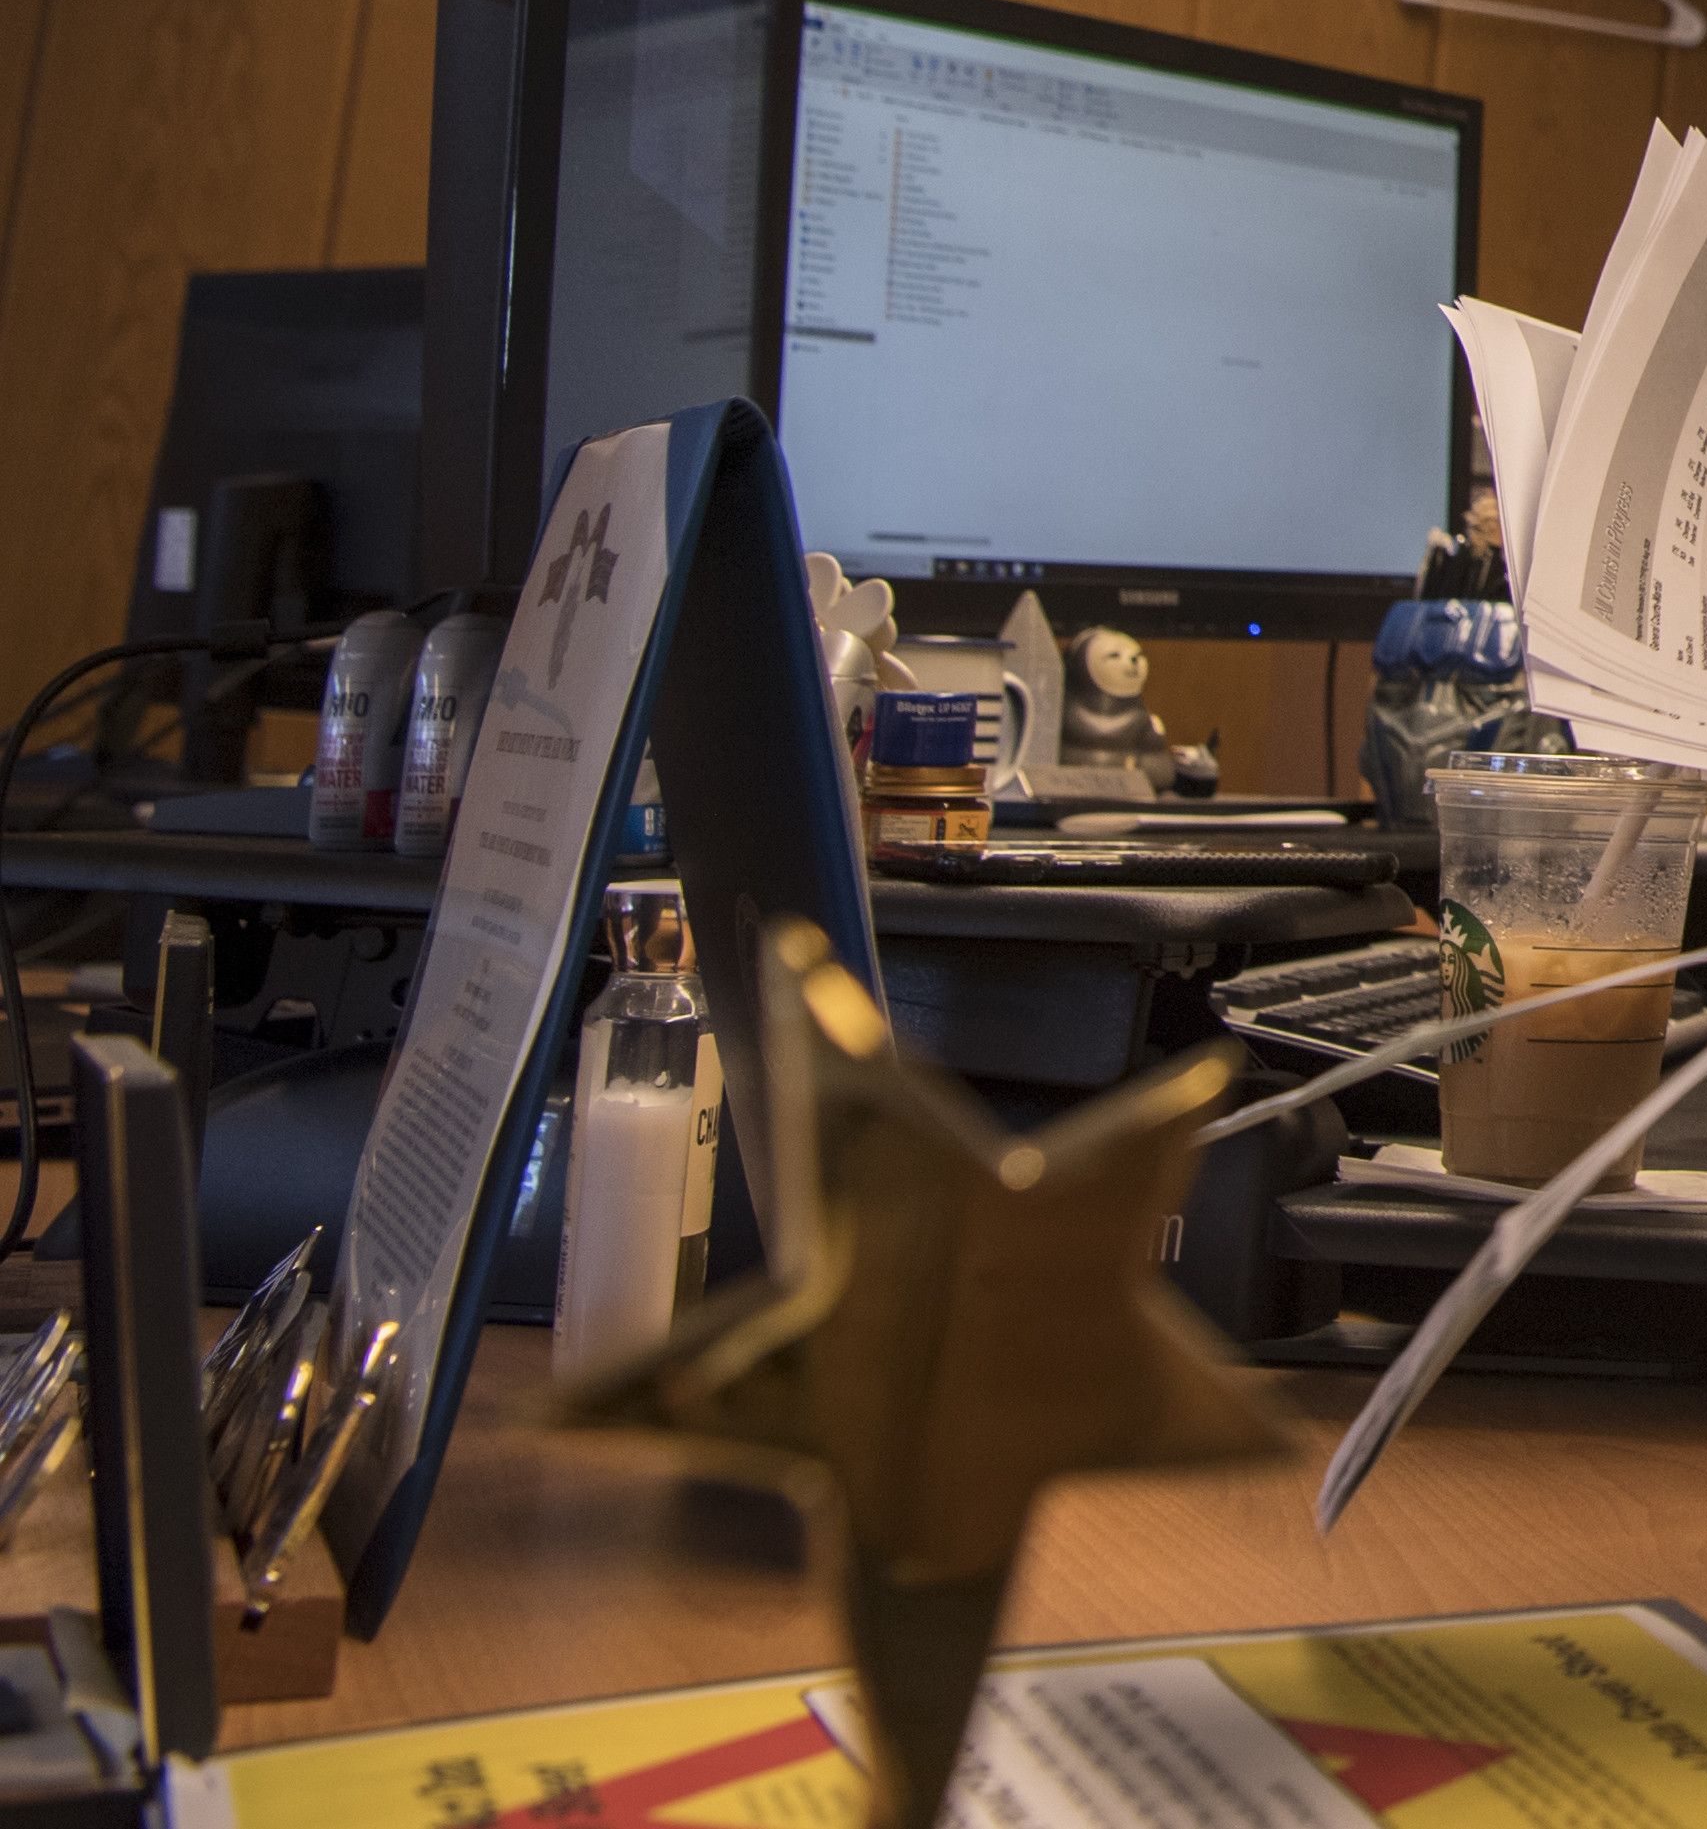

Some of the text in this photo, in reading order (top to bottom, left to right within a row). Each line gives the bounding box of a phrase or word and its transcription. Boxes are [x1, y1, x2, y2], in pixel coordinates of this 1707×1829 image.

[1595, 481, 1635, 624] All Courts in Progress
